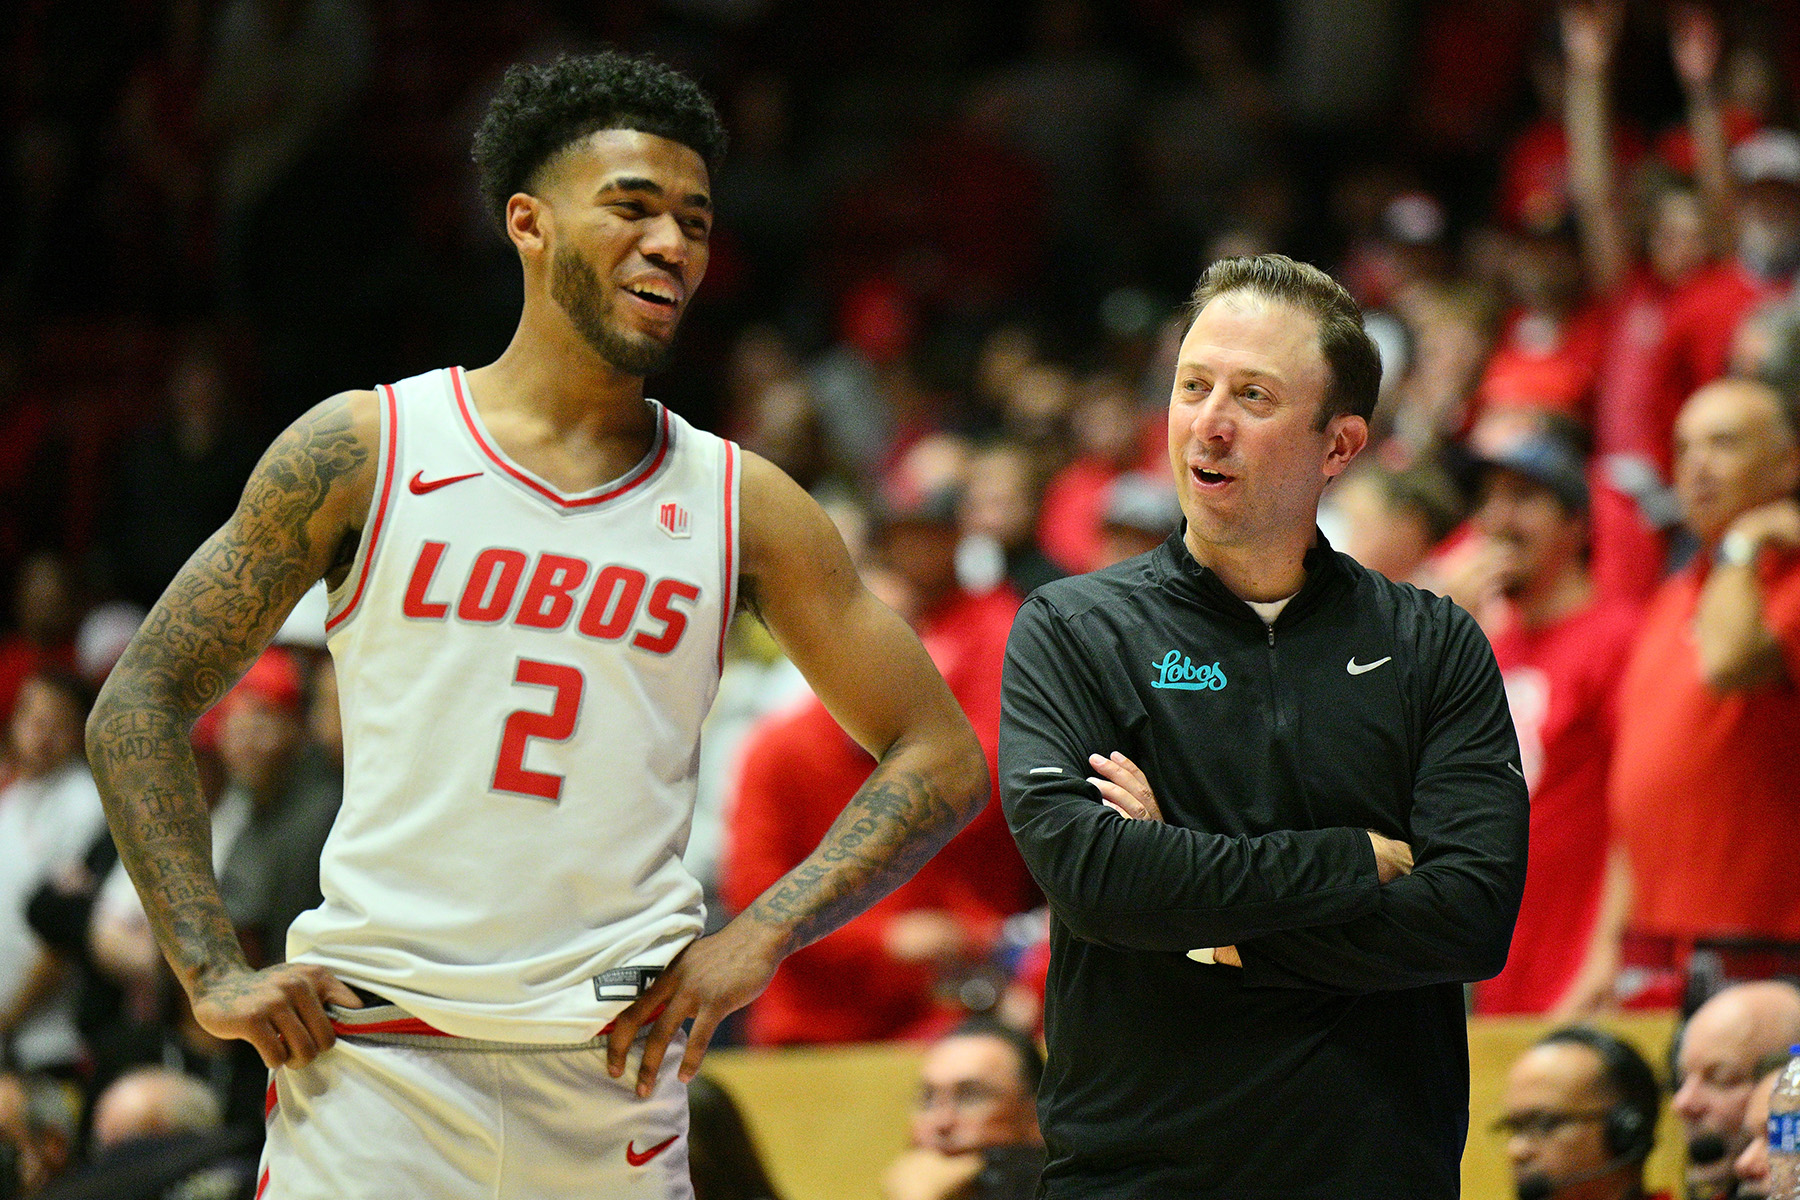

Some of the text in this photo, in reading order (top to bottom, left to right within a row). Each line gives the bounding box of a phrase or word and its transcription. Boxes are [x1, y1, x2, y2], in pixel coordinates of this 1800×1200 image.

[402, 539, 701, 656] LOBOS
[1150, 649, 1227, 691] Lobos
[103, 711, 167, 744] SELF
[488, 655, 588, 806] 2
[107, 735, 174, 774] MADE
[822, 817, 878, 863] GOD
